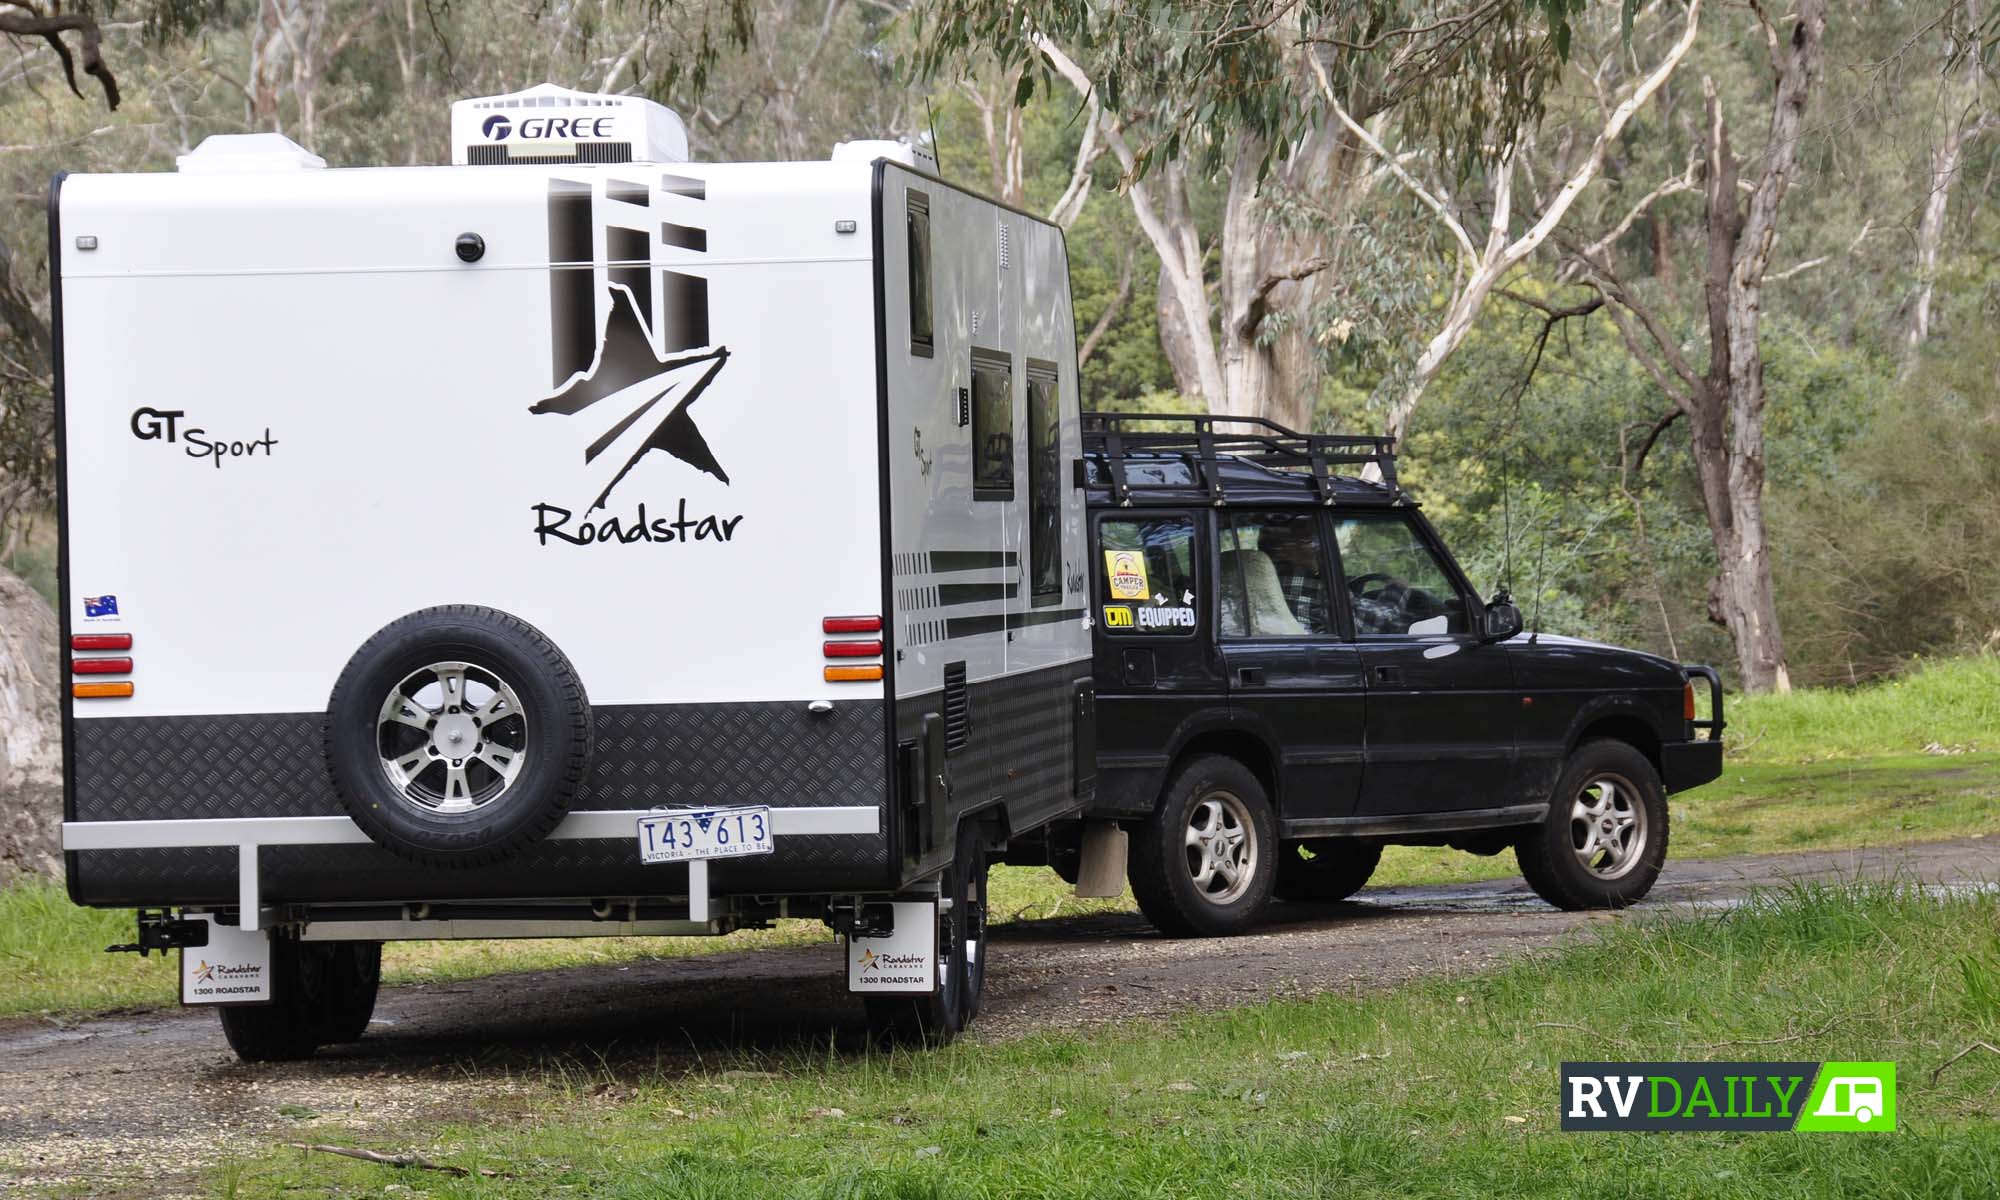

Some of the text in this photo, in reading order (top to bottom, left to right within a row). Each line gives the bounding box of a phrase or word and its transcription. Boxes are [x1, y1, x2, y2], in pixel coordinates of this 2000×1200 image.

[519, 117, 615, 139] GREE
[130, 406, 279, 469] GT Sport
[531, 498, 744, 546] Roadstar
[1113, 576, 1144, 588] CAMPER
[1138, 607, 1196, 628] EQUIPPED
[644, 814, 765, 851] T43 613
[647, 851, 684, 861] VICTORIA
[696, 848, 710, 856] THE
[714, 844, 738, 854] PLACE
[757, 843, 766, 851] BE
[193, 986, 261, 995] 1300 ROADSTAR
[859, 976, 924, 984] 1300 ROADSTAR
